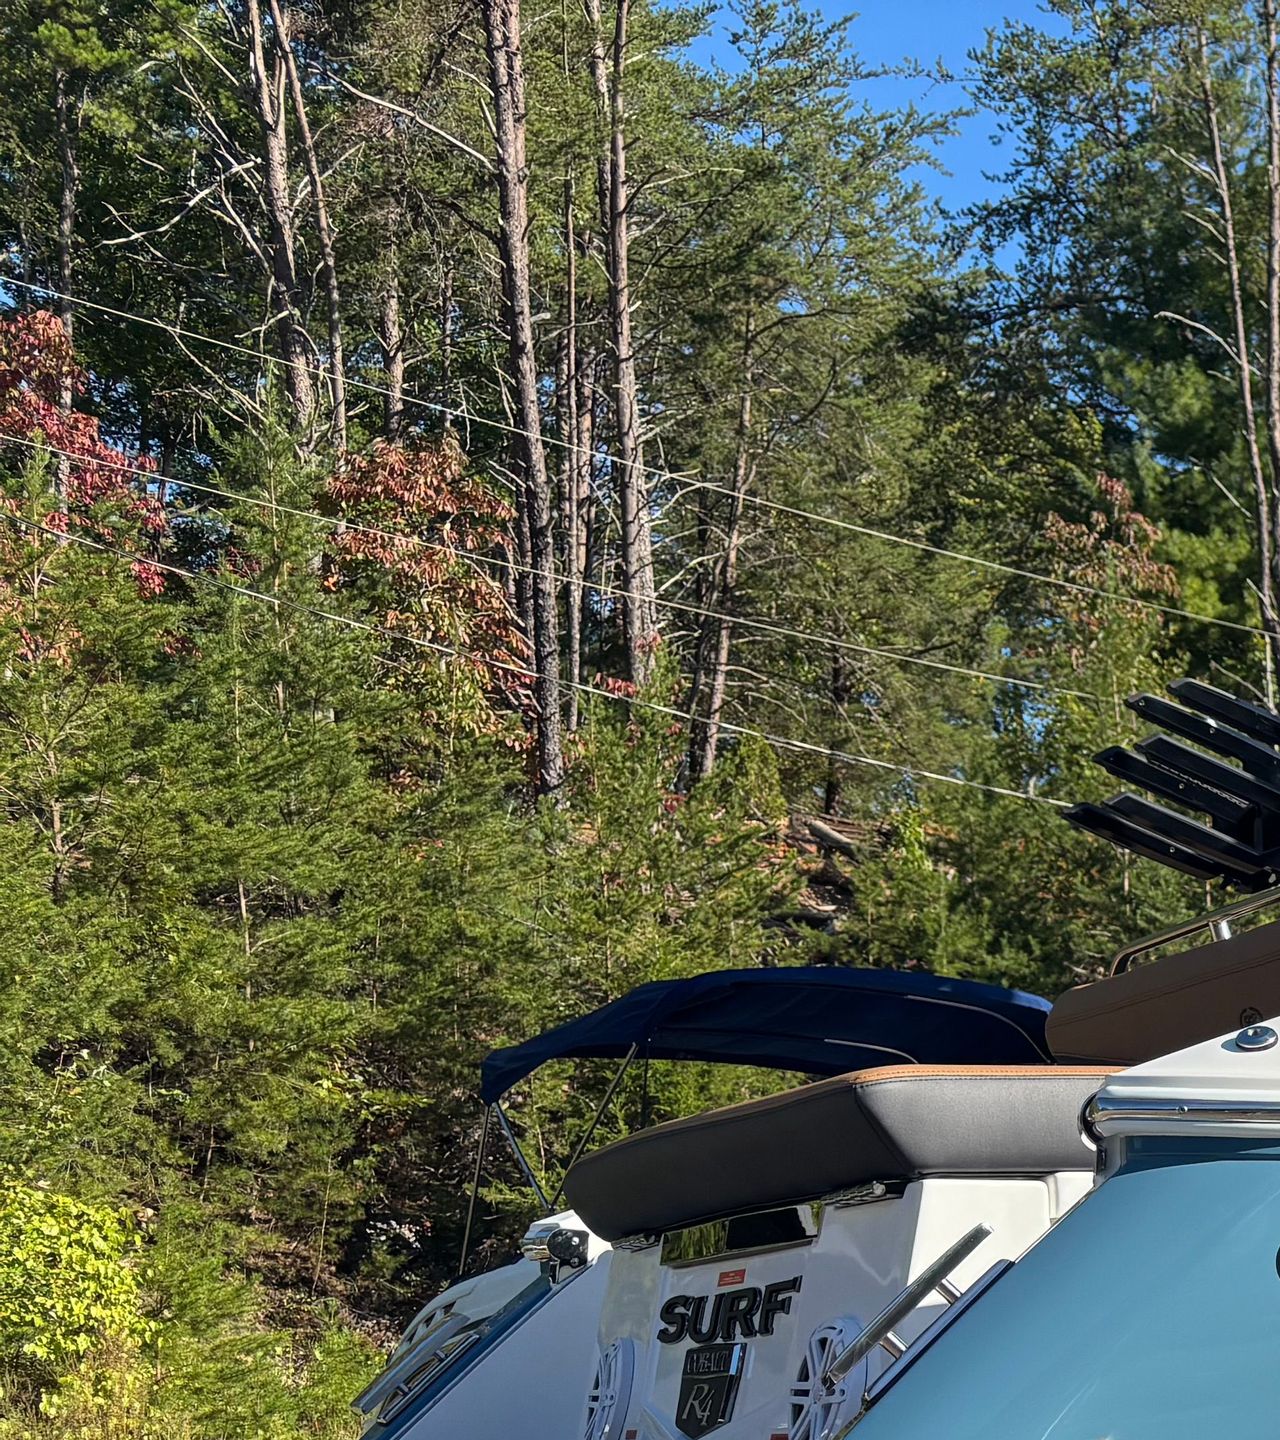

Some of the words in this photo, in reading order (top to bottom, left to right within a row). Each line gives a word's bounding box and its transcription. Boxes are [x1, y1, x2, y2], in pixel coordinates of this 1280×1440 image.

[656, 1274, 803, 1345] SURF
[686, 1350, 729, 1374] COBALT
[681, 1383, 715, 1426] R4
